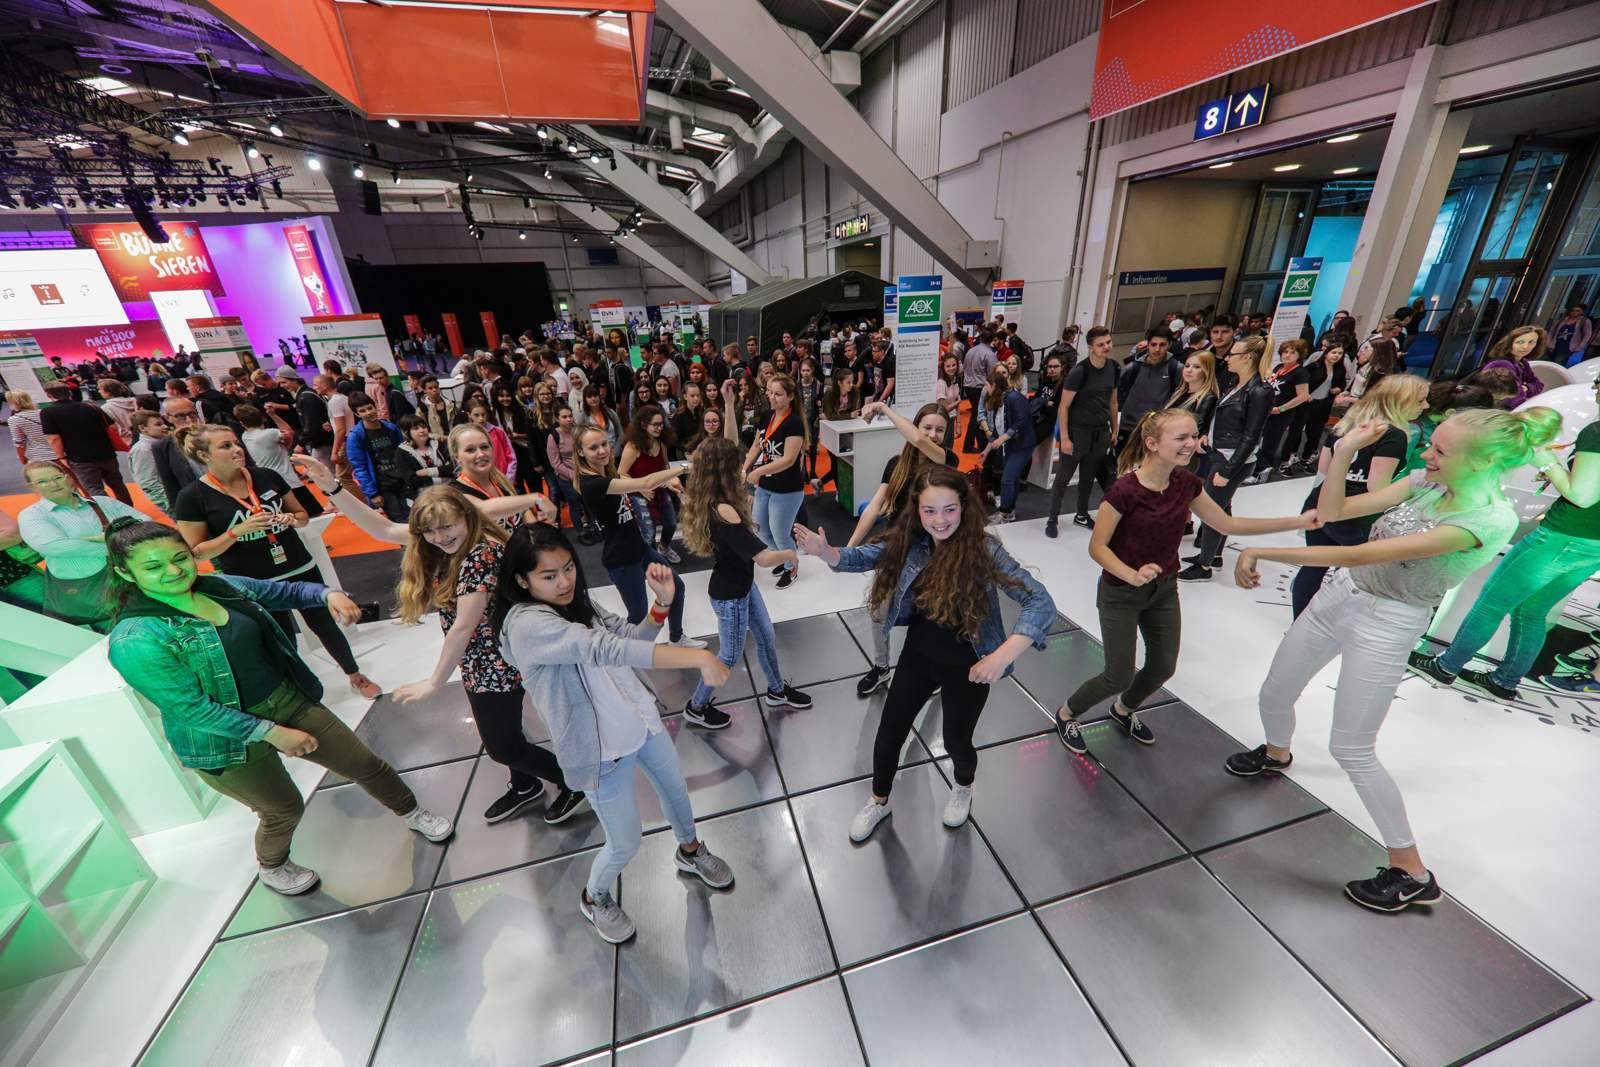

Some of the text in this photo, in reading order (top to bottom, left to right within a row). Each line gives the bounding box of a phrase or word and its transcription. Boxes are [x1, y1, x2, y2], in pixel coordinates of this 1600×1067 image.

[1203, 106, 1220, 131] 8
[148, 254, 212, 279] SIEBEN
[1132, 275, 1168, 285] Information
[1289, 278, 1312, 290] AOK
[906, 299, 934, 314] AOK
[194, 330, 214, 339] BVN
